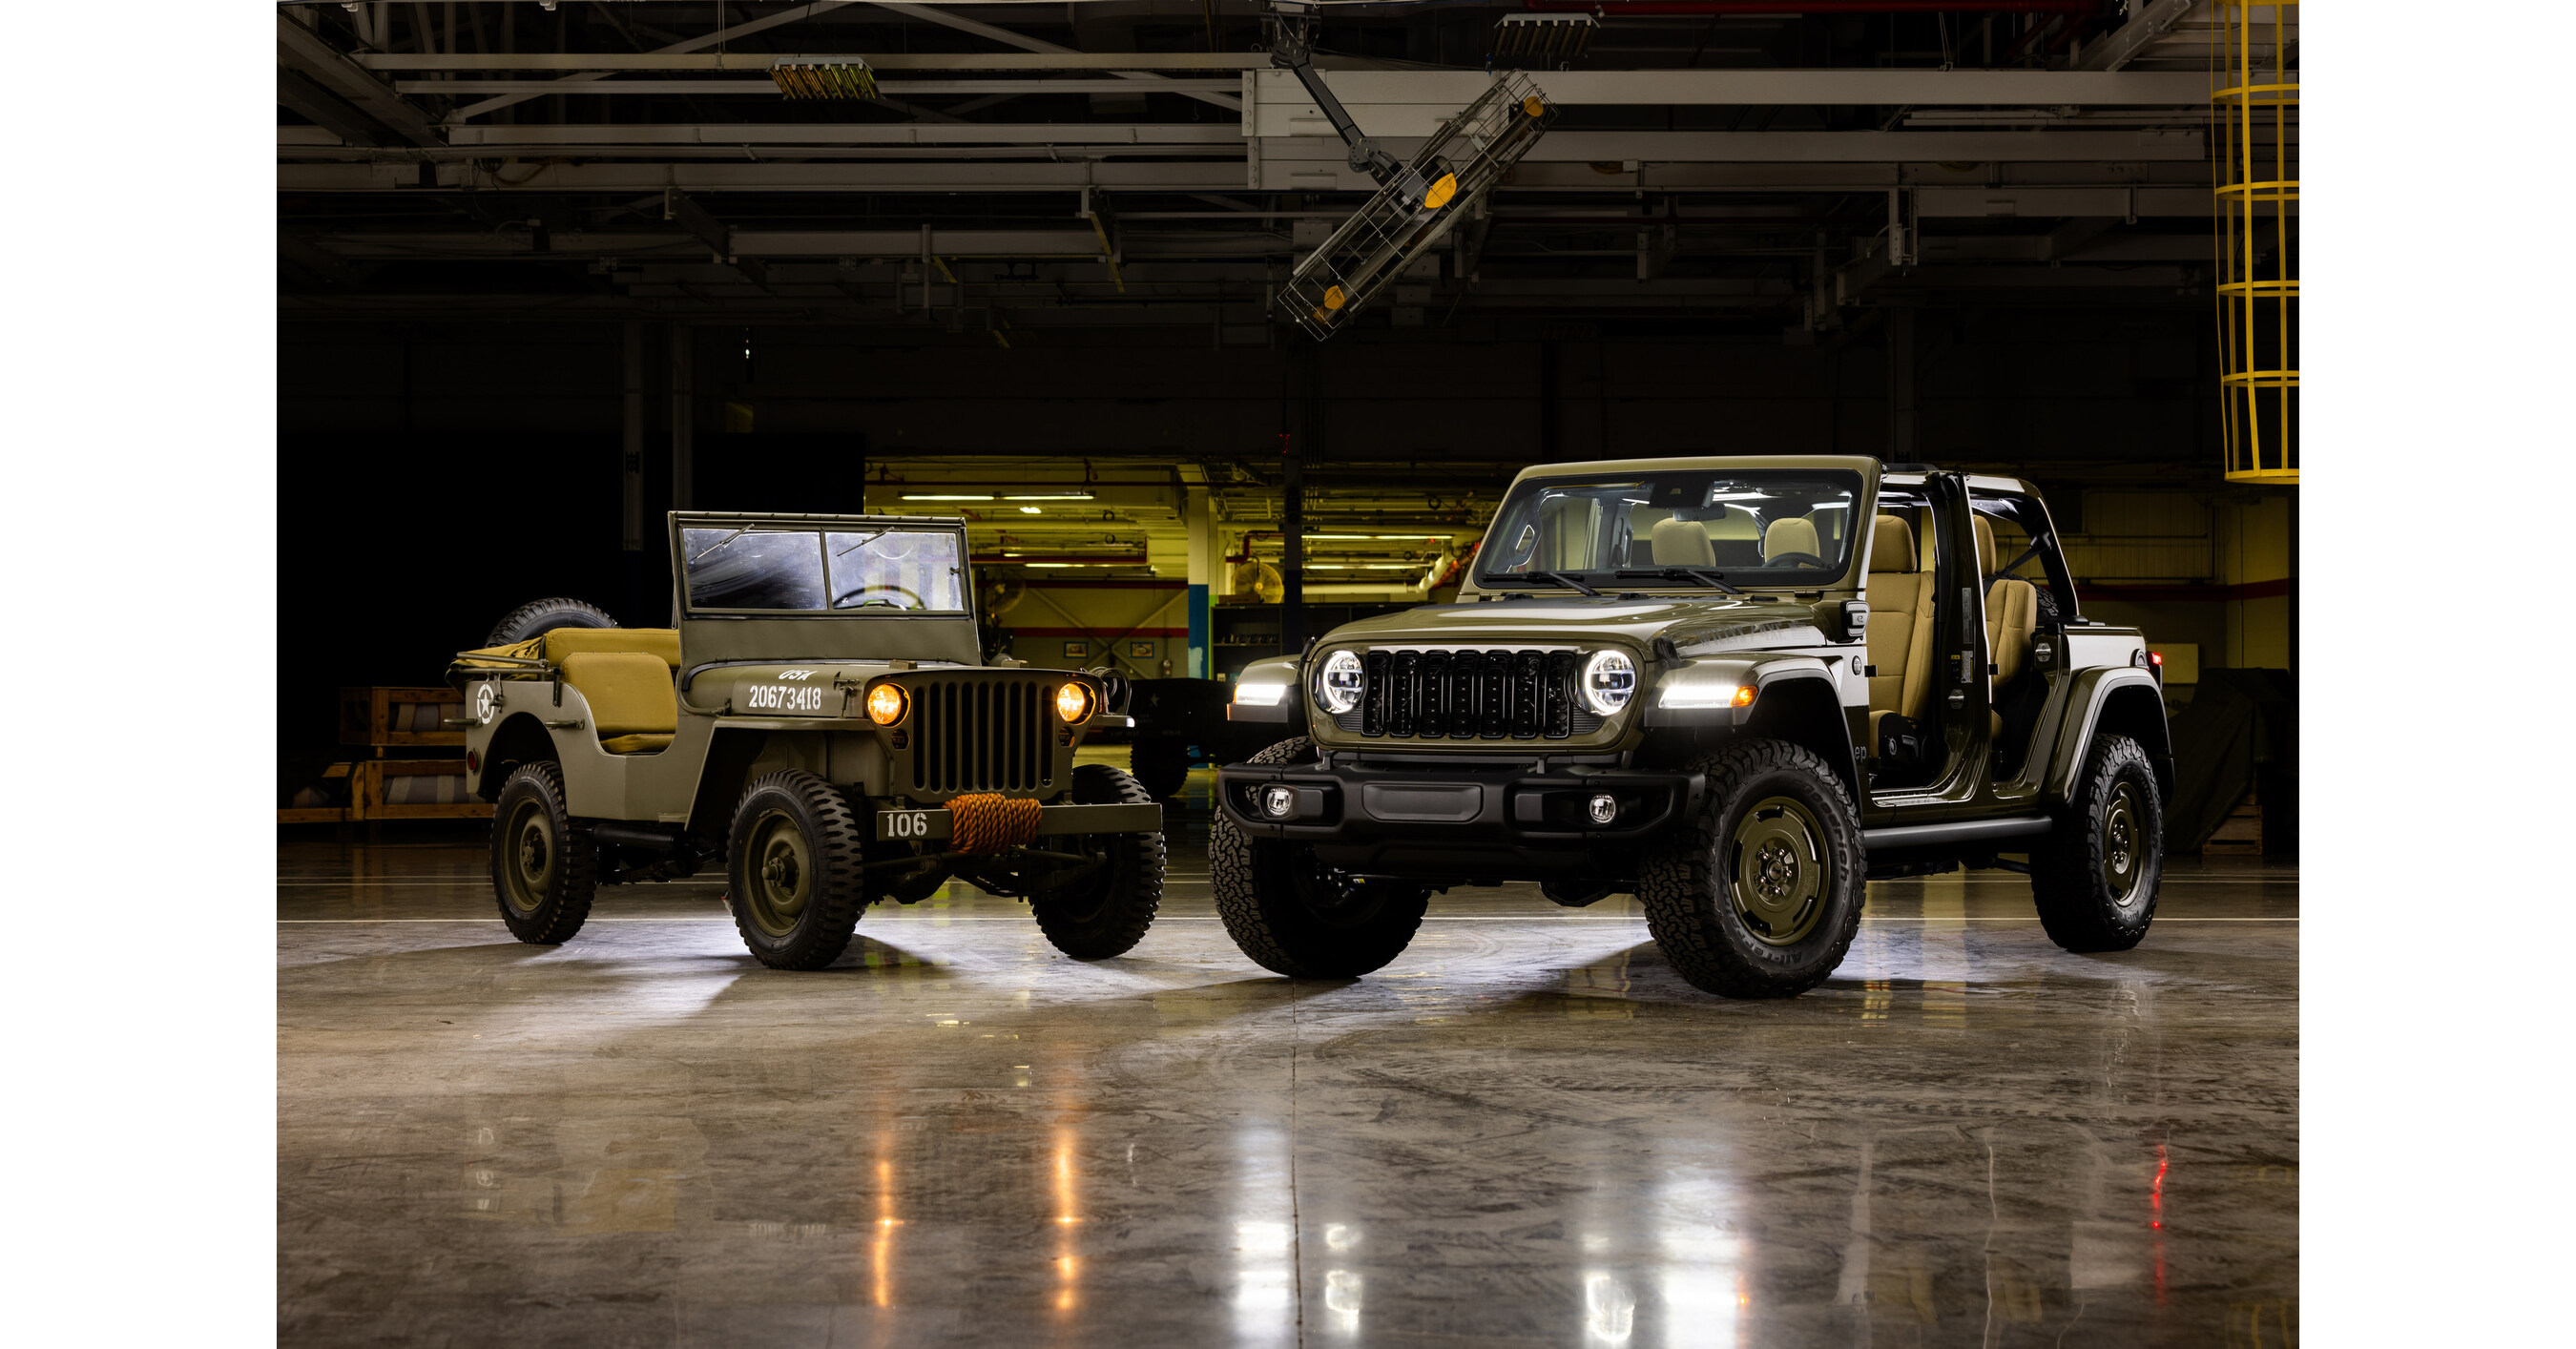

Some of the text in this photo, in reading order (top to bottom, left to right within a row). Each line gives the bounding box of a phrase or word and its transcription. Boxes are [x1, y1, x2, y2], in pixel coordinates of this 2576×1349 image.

[748, 685, 821, 711] 20673418
[1854, 745, 1867, 764] ep
[886, 812, 928, 838] 106
[1790, 777, 1851, 882] FGoodrich
